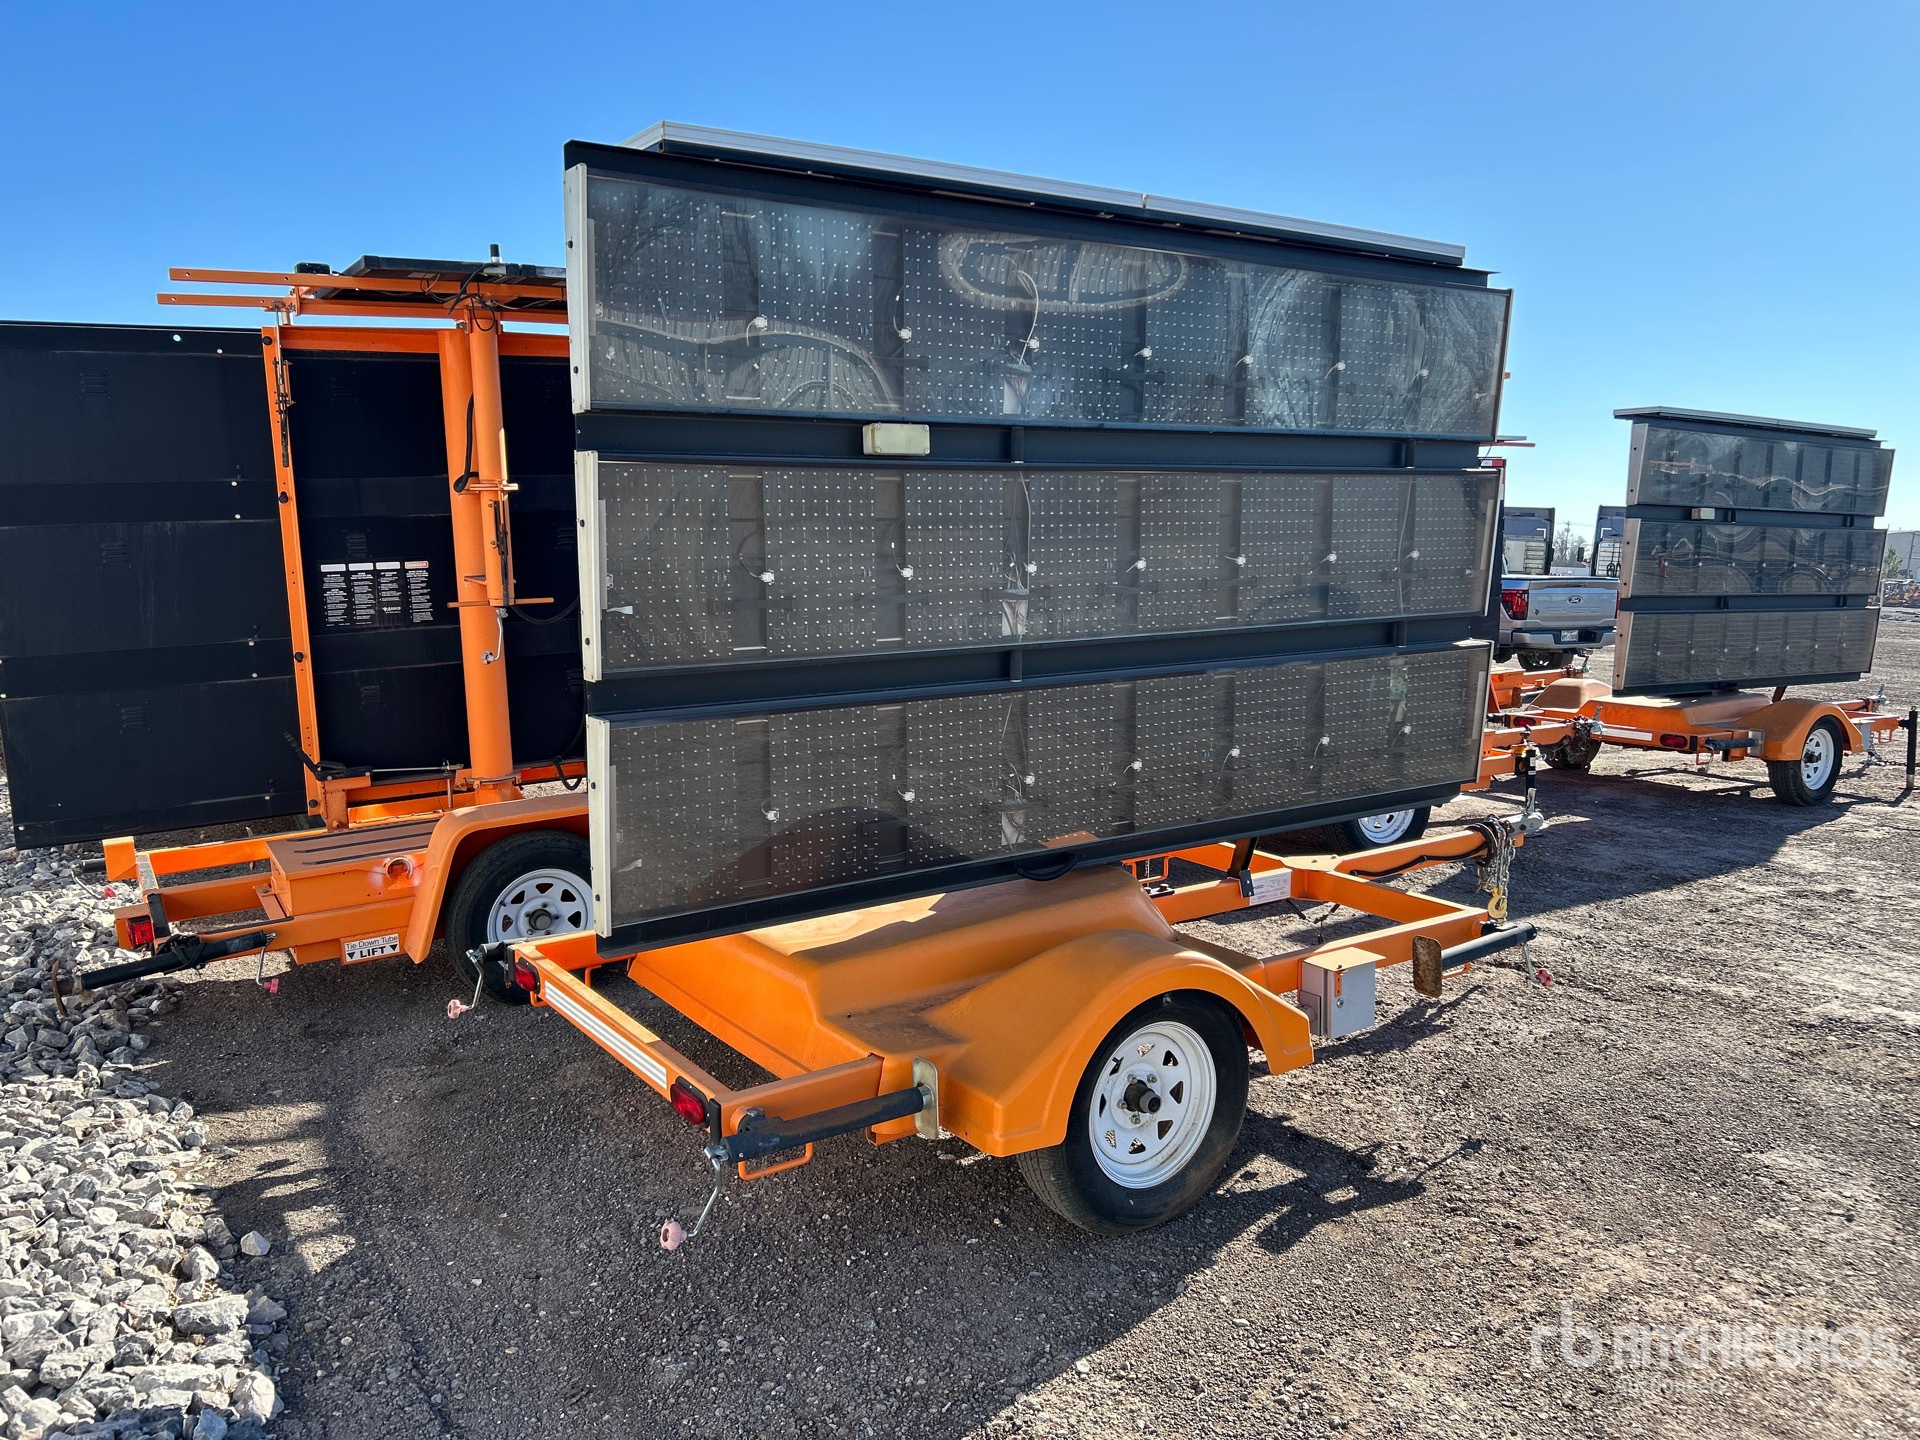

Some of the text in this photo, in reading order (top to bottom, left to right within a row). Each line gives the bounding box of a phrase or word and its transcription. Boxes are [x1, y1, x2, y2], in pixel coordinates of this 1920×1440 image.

[359, 939, 379, 948] Down
[382, 935, 398, 944] Tube
[360, 946, 386, 958] LIFT
